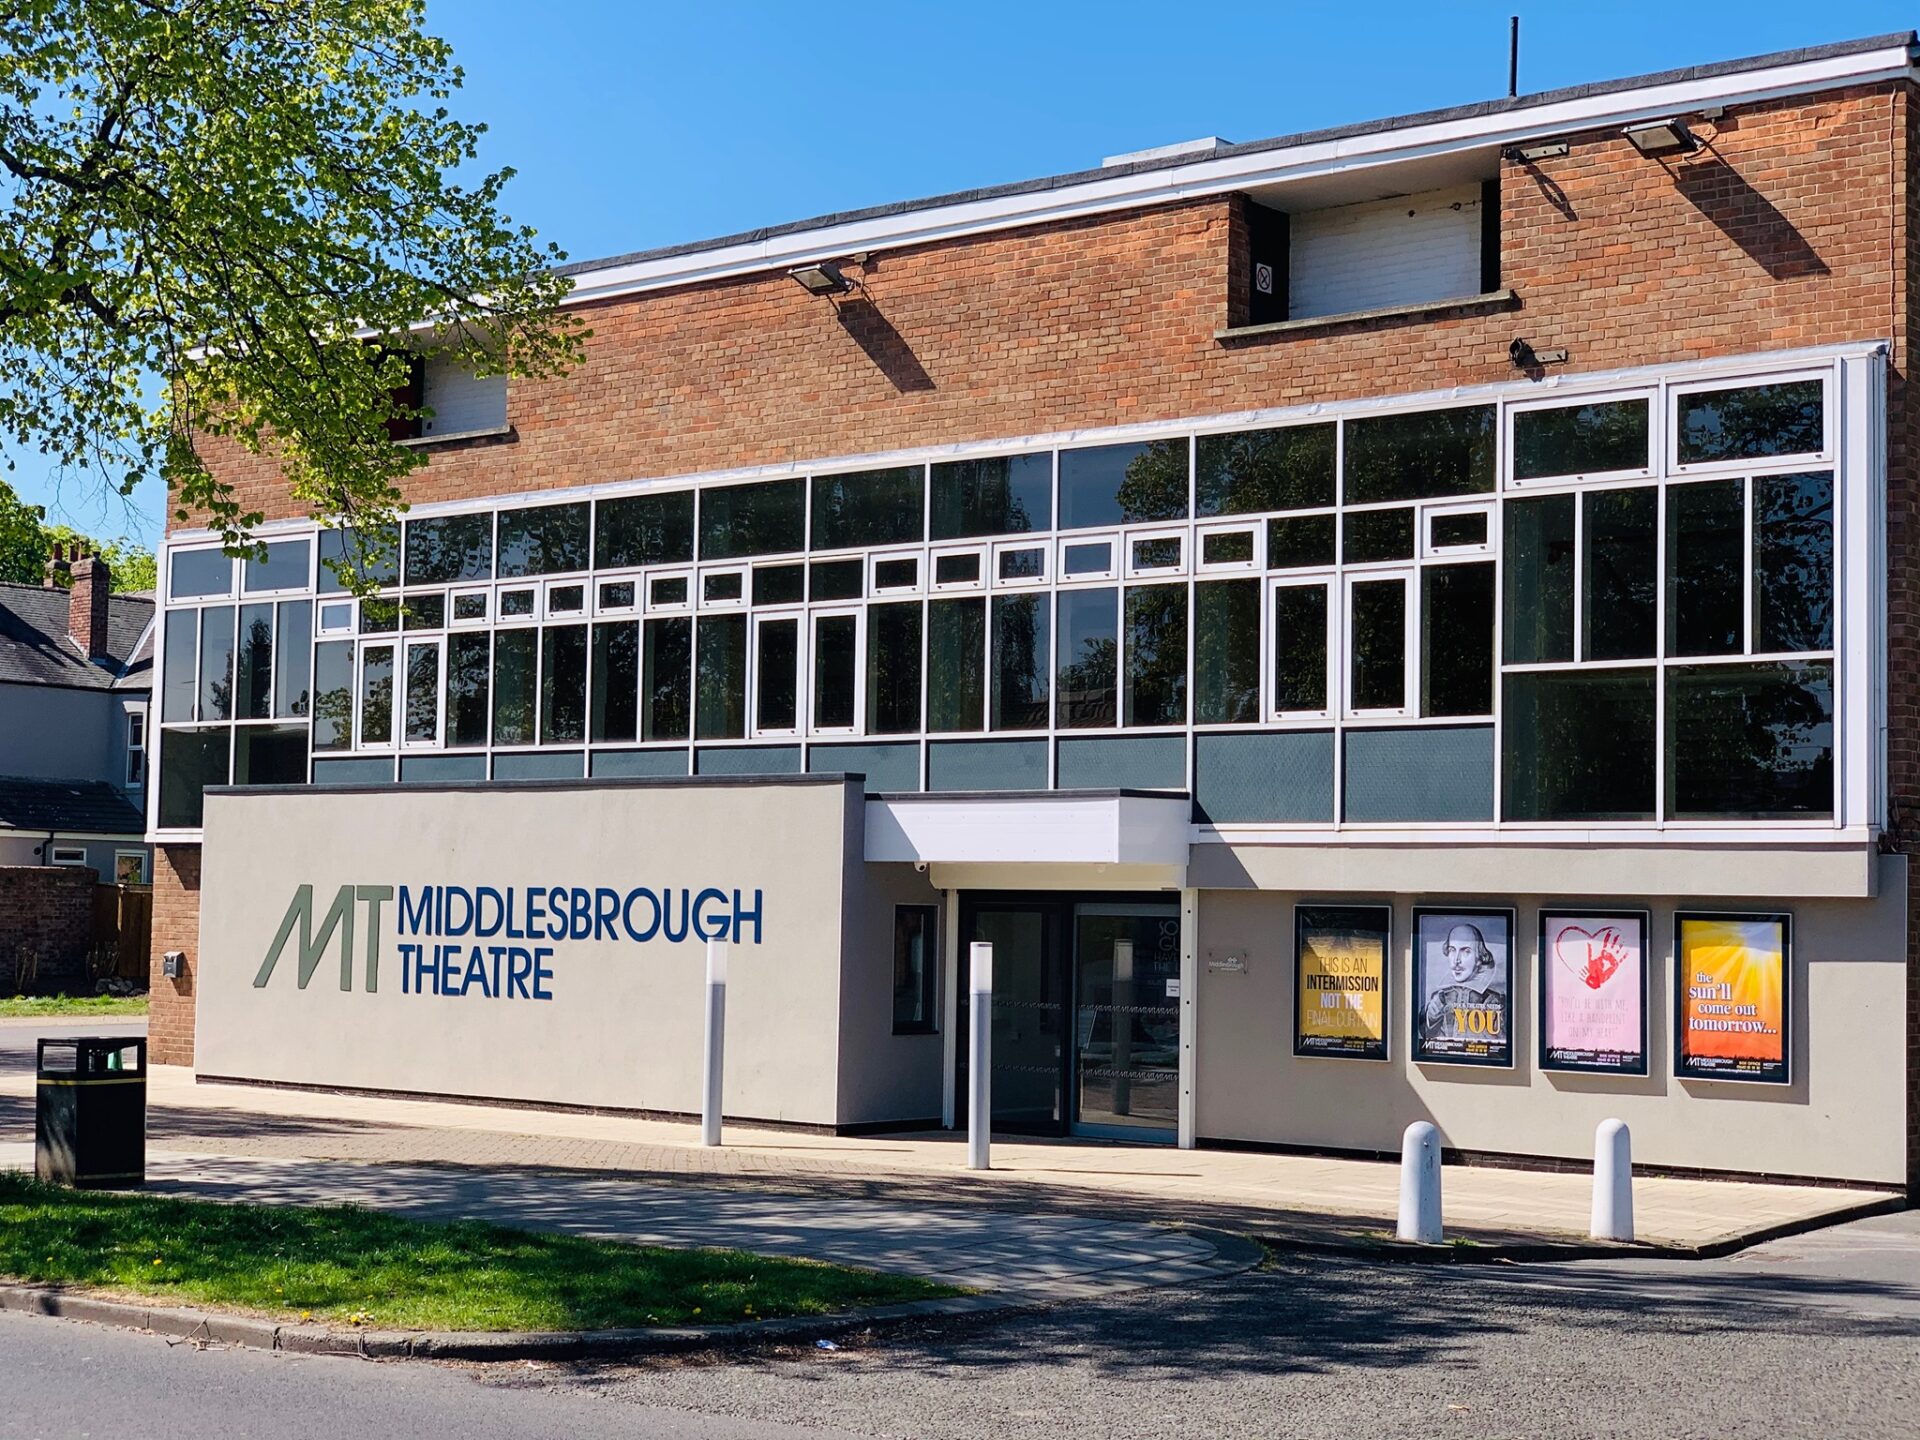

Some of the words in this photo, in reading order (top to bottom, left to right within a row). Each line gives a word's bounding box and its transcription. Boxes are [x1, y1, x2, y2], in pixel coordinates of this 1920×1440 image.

[398, 885, 763, 944] MIDDLESBROUGH
[1158, 920, 1179, 936] SO
[253, 884, 393, 993] MT
[397, 943, 554, 1000] THEATRE
[1320, 957, 1339, 973] THIS
[1341, 957, 1350, 973] IS
[1352, 958, 1368, 973] AN
[1306, 974, 1379, 992] INTERMISSION
[1696, 972, 1712, 983] the
[1689, 983, 1731, 1000] sun'll
[1320, 992, 1341, 1009] NOT
[1344, 993, 1364, 1010] THE
[1698, 1003, 1732, 1015] come
[1735, 1004, 1756, 1015] out
[1306, 1009, 1336, 1026] FINAL
[1336, 1010, 1378, 1028] CURTAIN
[1454, 1008, 1502, 1035] YOU
[1689, 1017, 1777, 1034] tomorrow...
